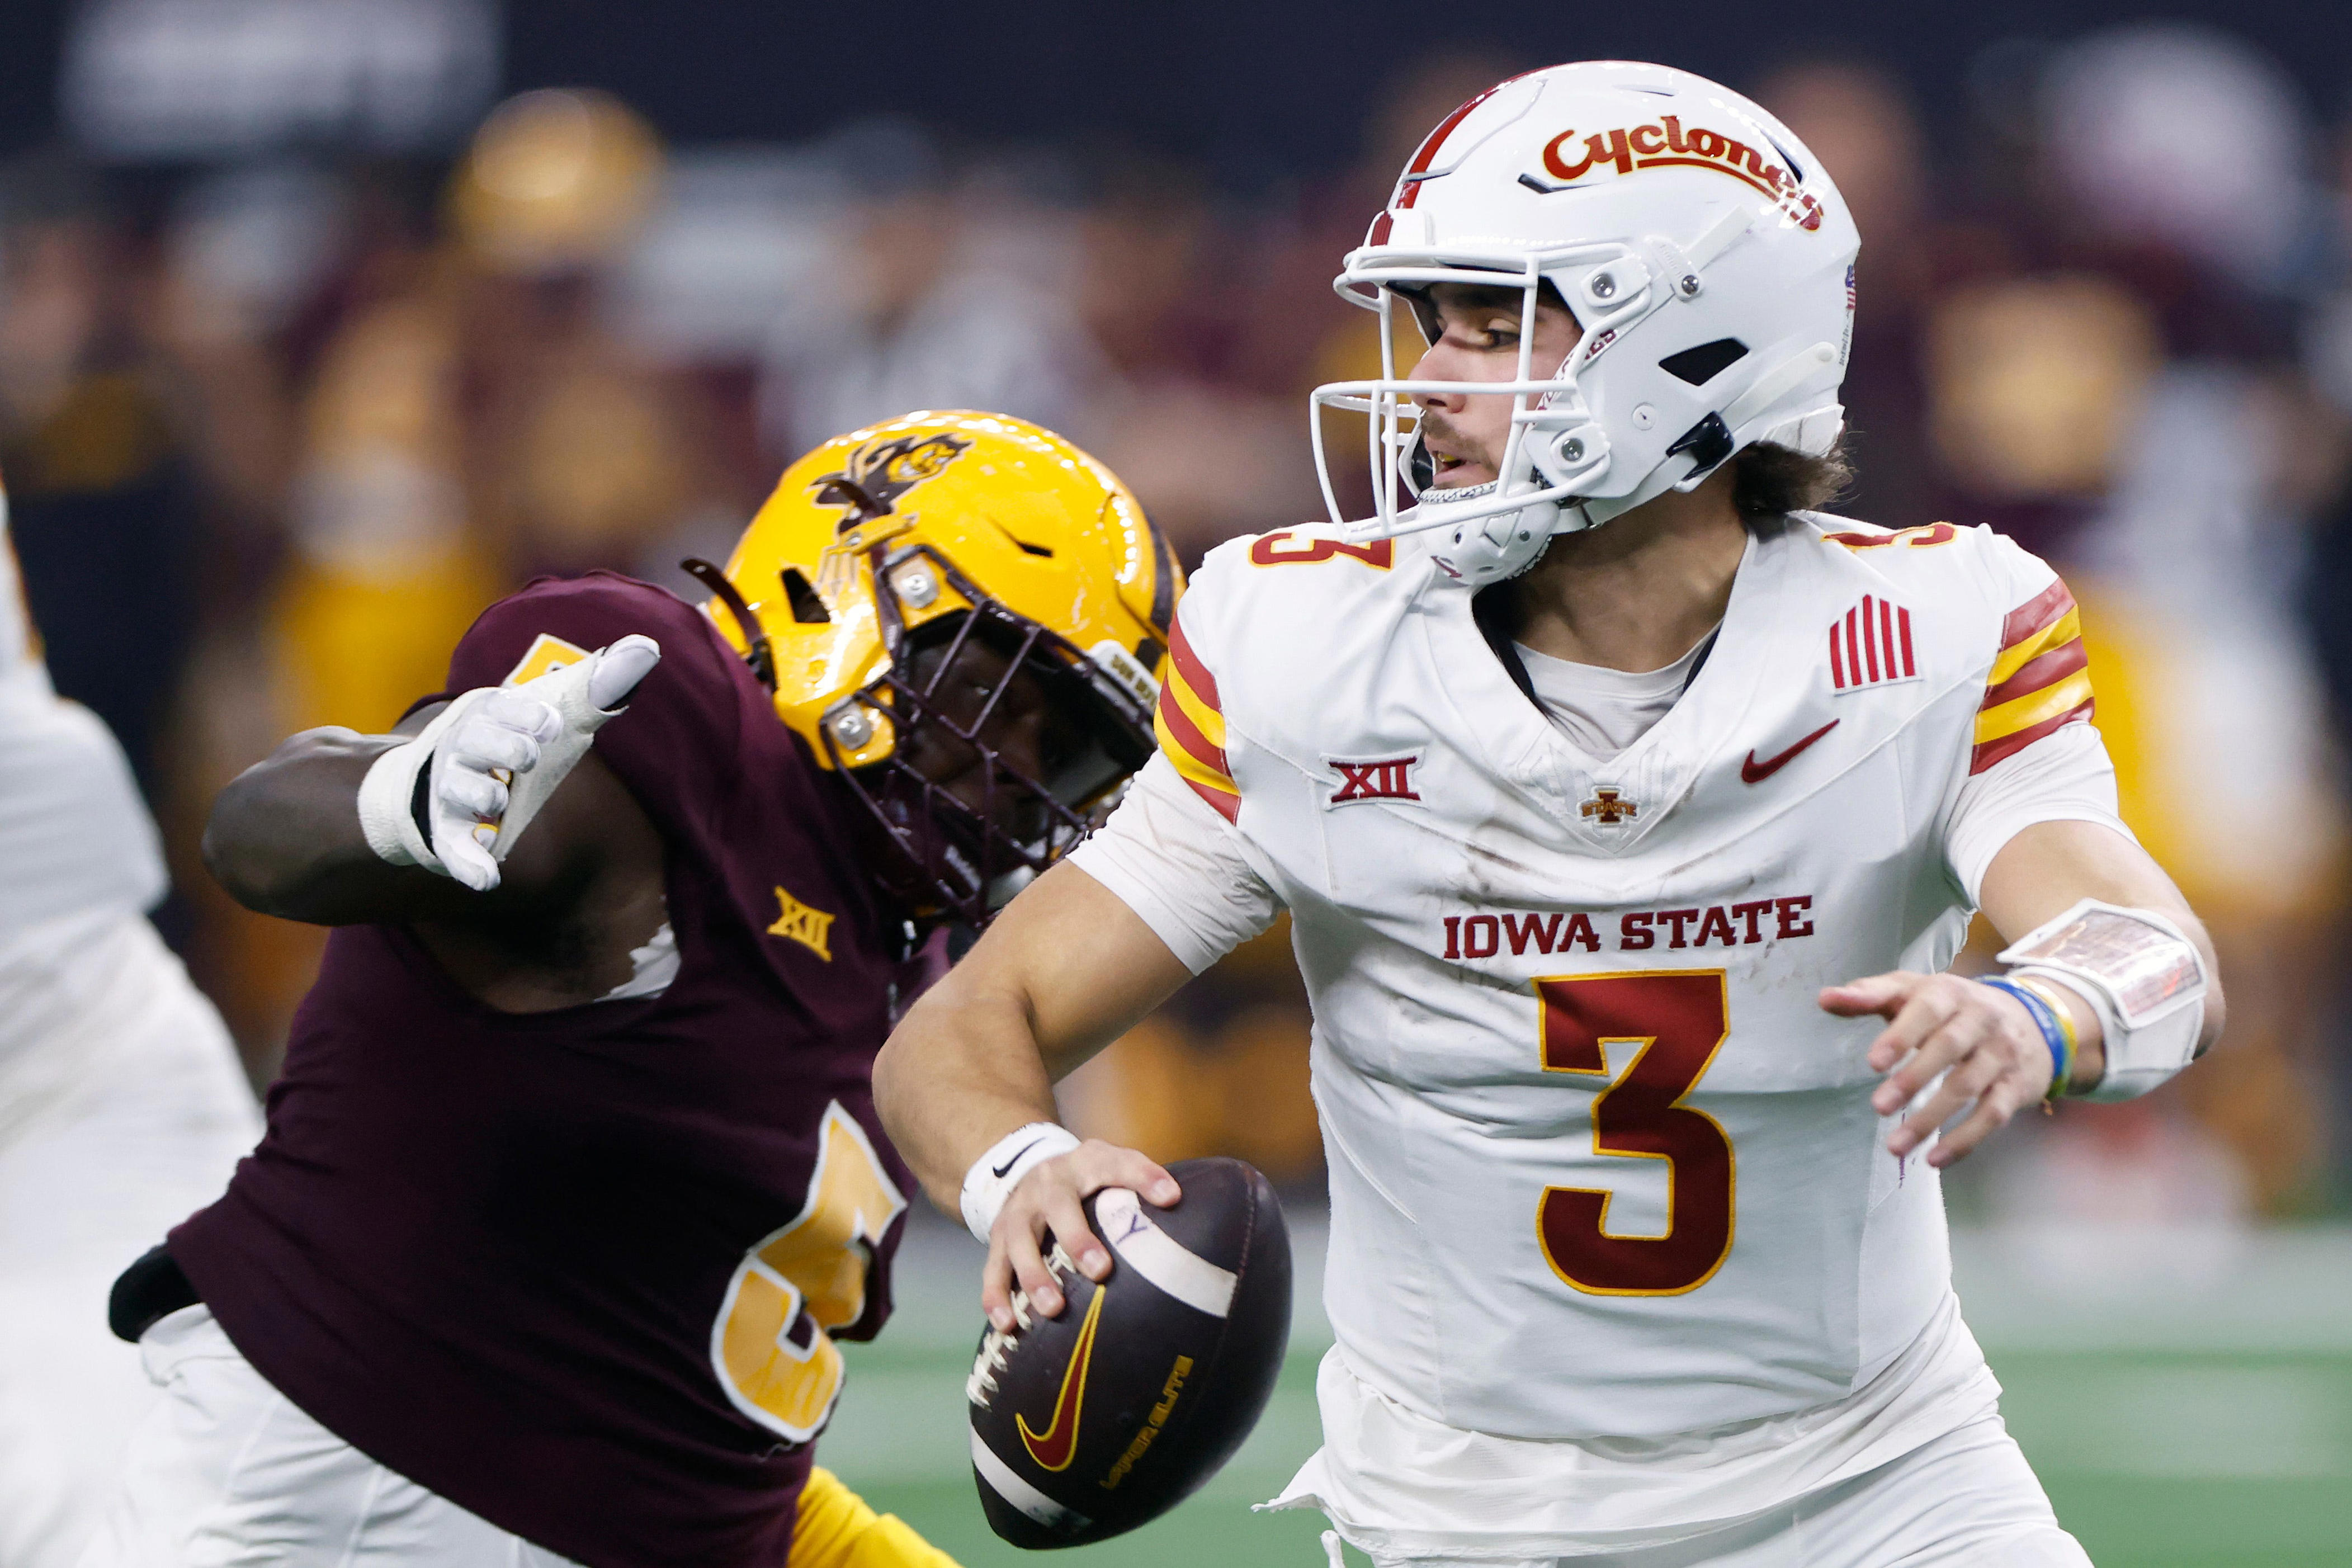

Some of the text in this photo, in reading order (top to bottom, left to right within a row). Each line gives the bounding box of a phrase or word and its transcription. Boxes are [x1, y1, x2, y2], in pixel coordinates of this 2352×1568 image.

[1329, 756, 1421, 803] XII
[1443, 895, 1814, 960] IOWA STATE
[1530, 967, 1737, 1297] 3
